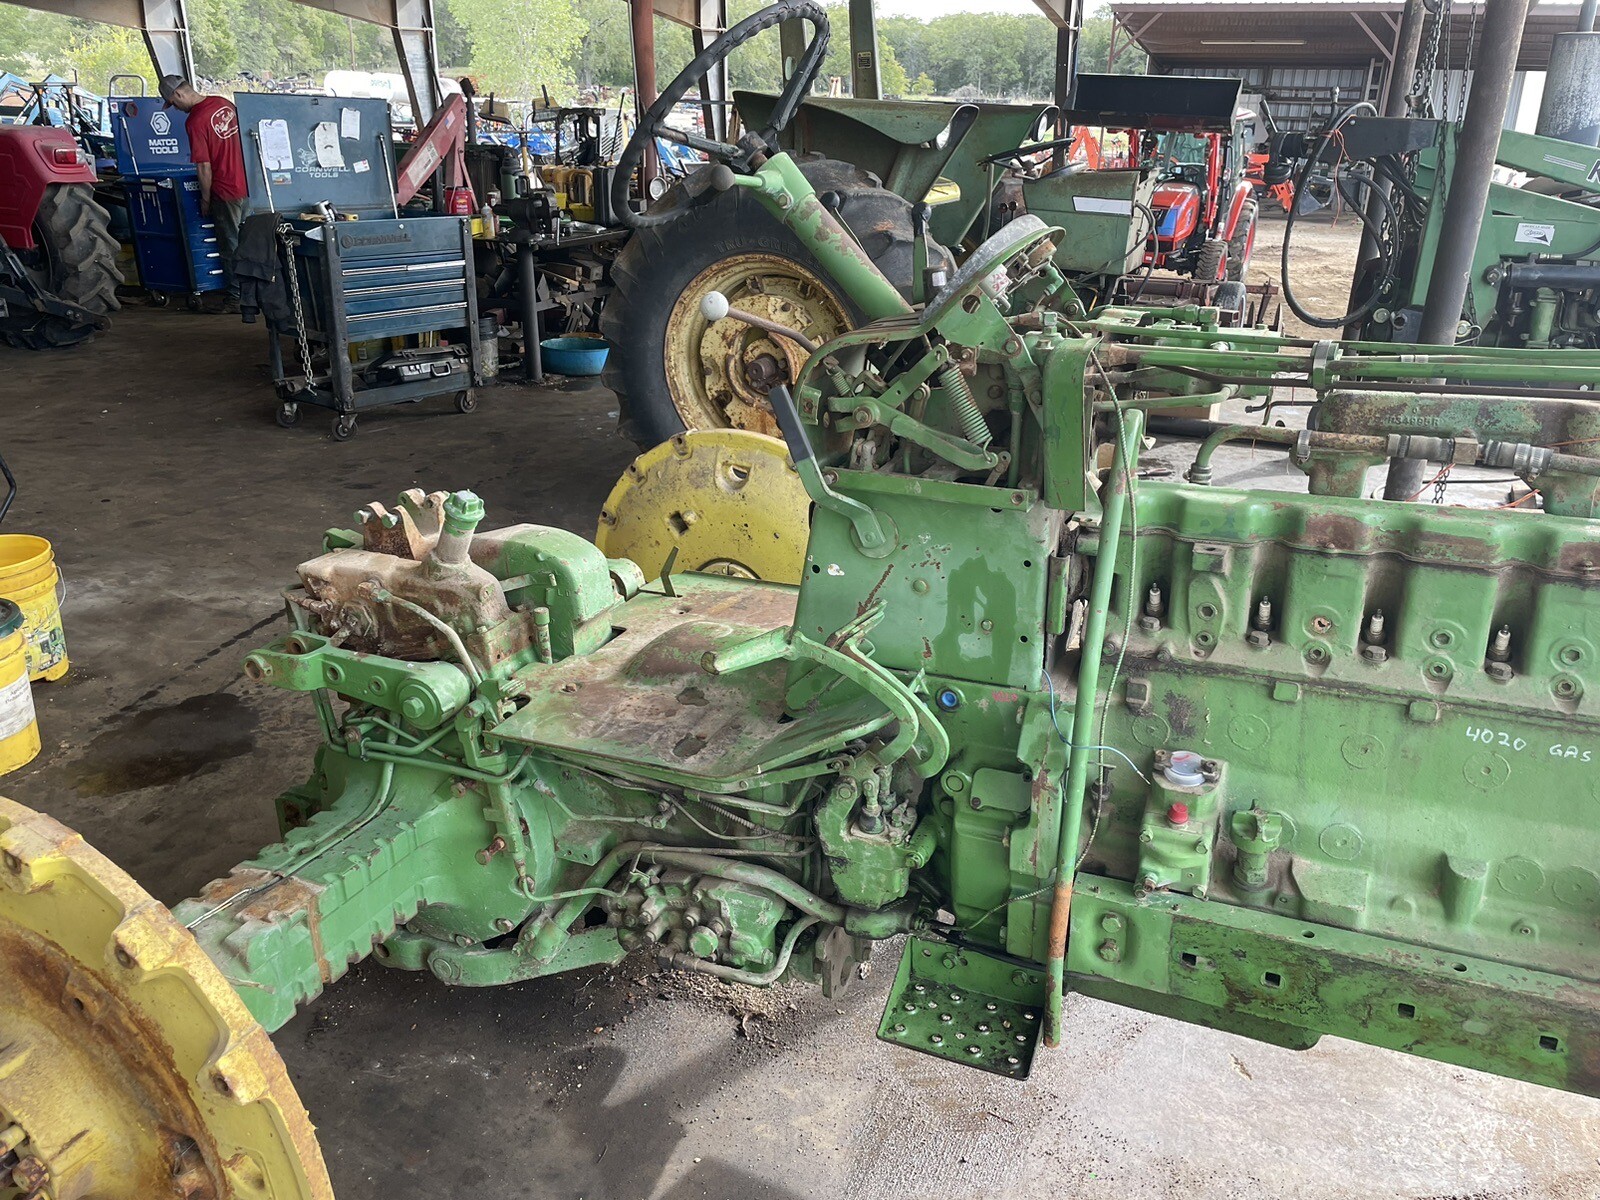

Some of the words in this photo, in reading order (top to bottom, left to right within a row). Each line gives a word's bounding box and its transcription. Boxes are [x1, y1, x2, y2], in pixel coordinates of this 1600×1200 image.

[148, 138, 178, 146] MATCO
[150, 146, 179, 154] TOOLS
[1466, 726, 1526, 751] 4020
[1549, 744, 1591, 762] GAS
